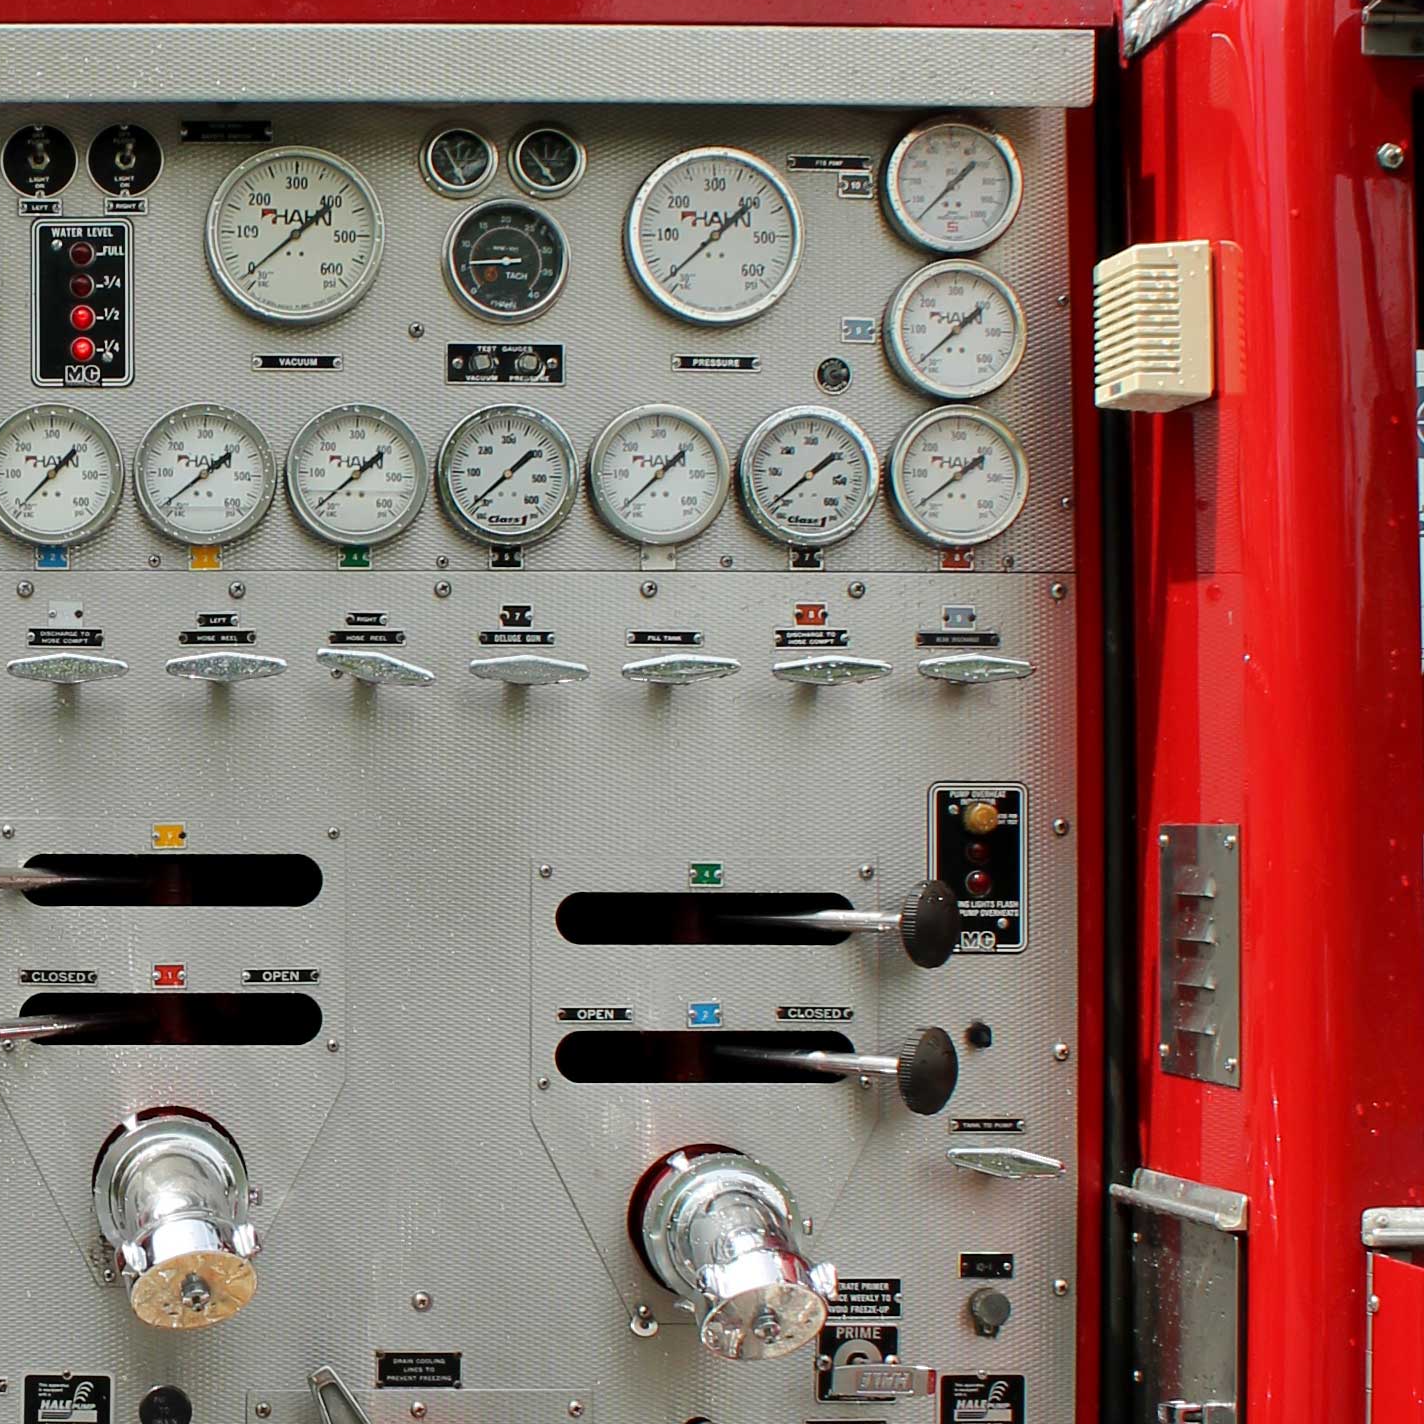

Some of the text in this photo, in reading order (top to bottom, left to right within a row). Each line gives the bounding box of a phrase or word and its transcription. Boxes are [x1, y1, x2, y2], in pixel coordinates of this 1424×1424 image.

[28, 176, 50, 184] LIGHT
[285, 176, 308, 190] 300
[703, 179, 726, 192] 300
[248, 192, 271, 206] 200
[319, 195, 343, 209] 400
[667, 195, 690, 209] 200
[738, 196, 761, 209] 400
[50, 227, 114, 238] WATER LEVEL
[236, 226, 259, 238] 100
[333, 230, 357, 243] 500
[657, 228, 679, 241] 100
[753, 231, 776, 245] 500
[102, 245, 124, 257] FULL
[248, 261, 256, 275] 0
[319, 262, 343, 276] 600
[741, 264, 765, 277] 600
[505, 271, 528, 280] TACH
[103, 275, 122, 289] 3/4
[527, 291, 540, 299] 40
[103, 307, 120, 321] 1/2
[278, 358, 318, 366] VACUUM
[692, 358, 740, 368] PRESSURE
[43, 429, 60, 440] 300
[349, 430, 366, 440] 300
[319, 442, 337, 452] 200
[5, 469, 22, 479] 100
[81, 470, 99, 480] 500
[309, 467, 326, 477] 100
[466, 468, 481, 477] 100
[385, 473, 402, 482] 500
[531, 474, 547, 483] 500
[72, 497, 90, 507] 600
[375, 499, 393, 508] 600
[523, 496, 539, 504] 600
[40, 630, 79, 638] DISCHARGE
[494, 634, 542, 643] DELUGE GUN
[949, 790, 1006, 798] PUMP OVERHEAT
[971, 900, 995, 908] LIGHTS
[996, 900, 1019, 908] FLASH
[980, 909, 1019, 917] OVERHEATS
[31, 972, 86, 982] CLOSED
[262, 971, 300, 981] OPEN
[576, 1009, 615, 1020] OPEN
[787, 1008, 842, 1019] CLOSED
[838, 1282, 889, 1291] ERATE PRIMER
[850, 1294, 880, 1302] WEEKLY
[881, 1294, 891, 1302] TO
[850, 1305, 890, 1313] FREEZE-UP
[835, 1326, 881, 1339] PRIME
[40, 1399, 73, 1410] HALE
[956, 1399, 988, 1409] HALE
